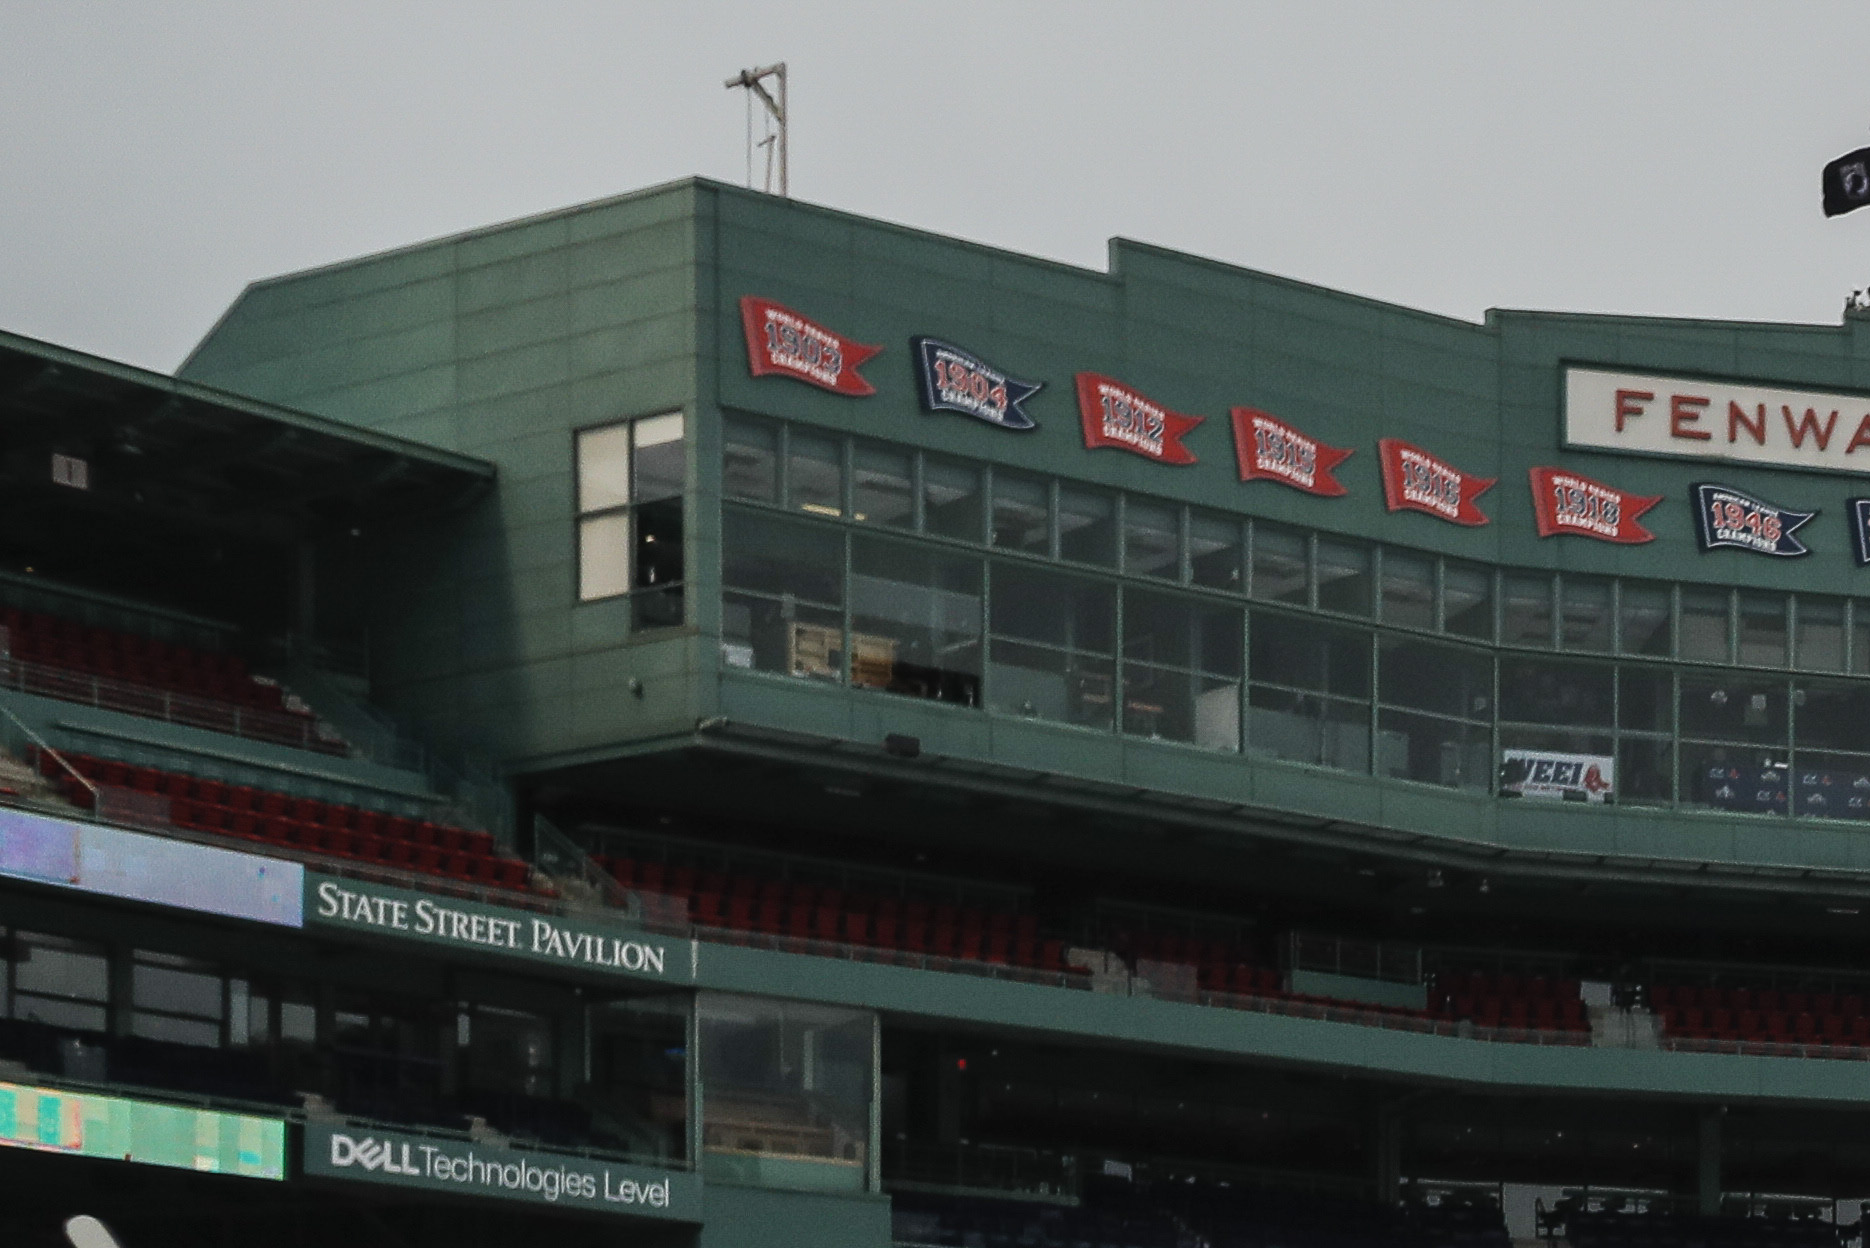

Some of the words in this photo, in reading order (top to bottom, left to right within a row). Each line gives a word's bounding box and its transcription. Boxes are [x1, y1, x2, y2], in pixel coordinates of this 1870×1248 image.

[934, 359, 1007, 412] 1904
[1101, 396, 1165, 443] 1912
[1711, 500, 1782, 543] 1946
[318, 881, 409, 931] STATE
[415, 899, 522, 949] STREET
[530, 918, 666, 975] PAVILION
[330, 1134, 421, 1176] DELL
[419, 1145, 597, 1202] Technologies
[605, 1169, 670, 1208] Level
